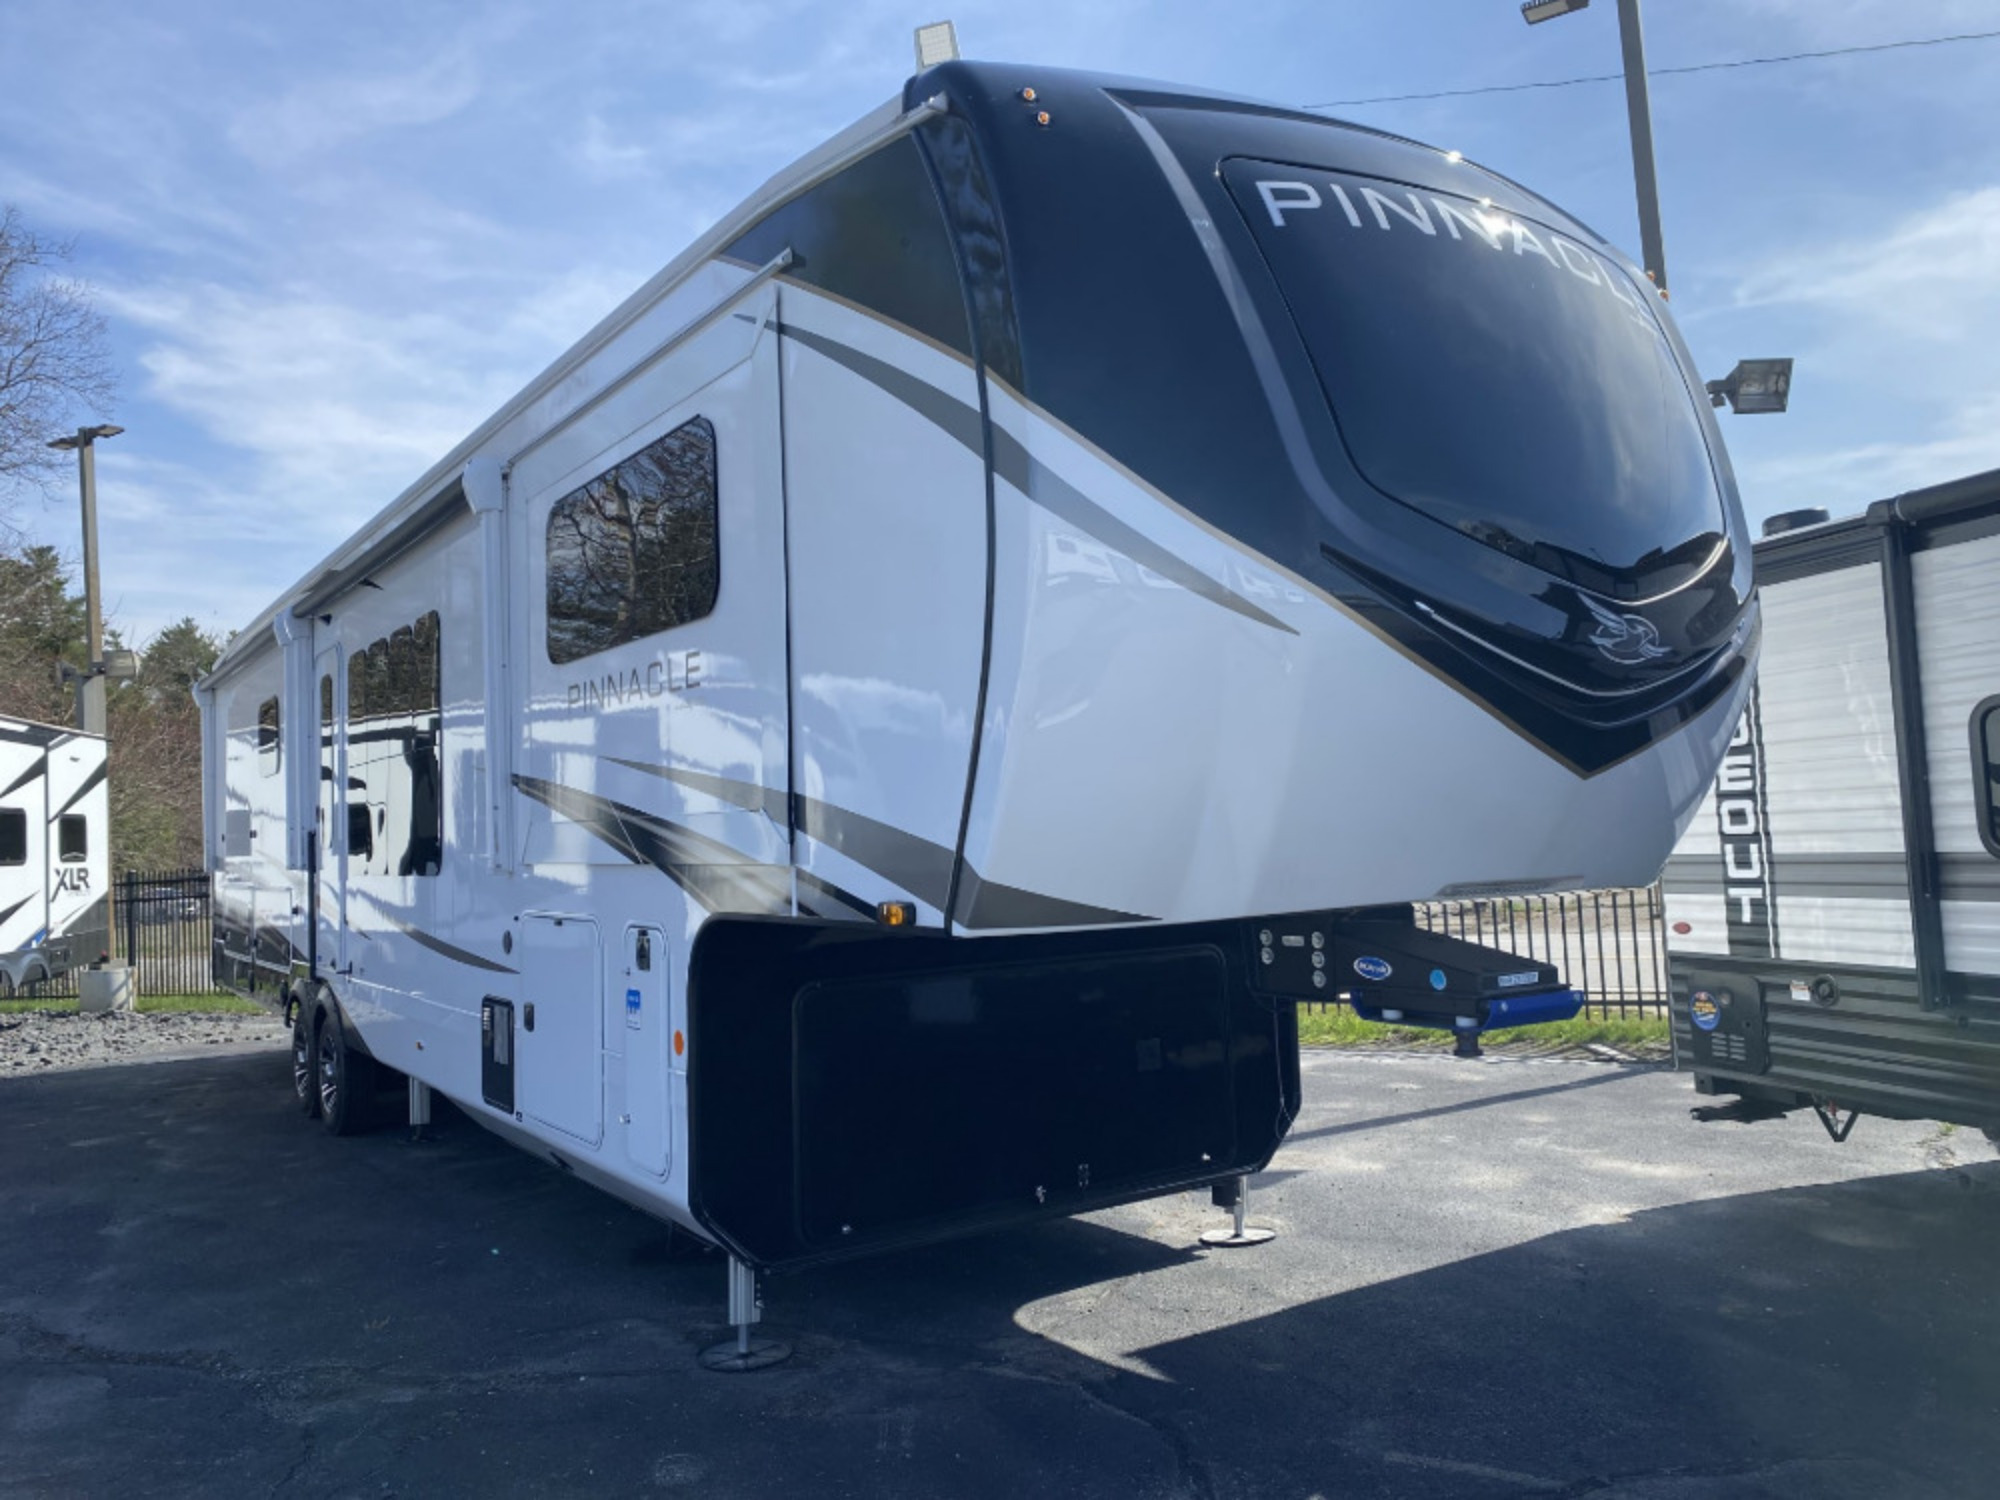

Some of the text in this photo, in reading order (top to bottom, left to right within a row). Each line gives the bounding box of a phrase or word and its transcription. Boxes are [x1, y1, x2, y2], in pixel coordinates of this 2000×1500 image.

[1255, 180, 1658, 337] PINNACLE
[567, 650, 701, 714] PINNACLE
[51, 867, 90, 903] XLR
